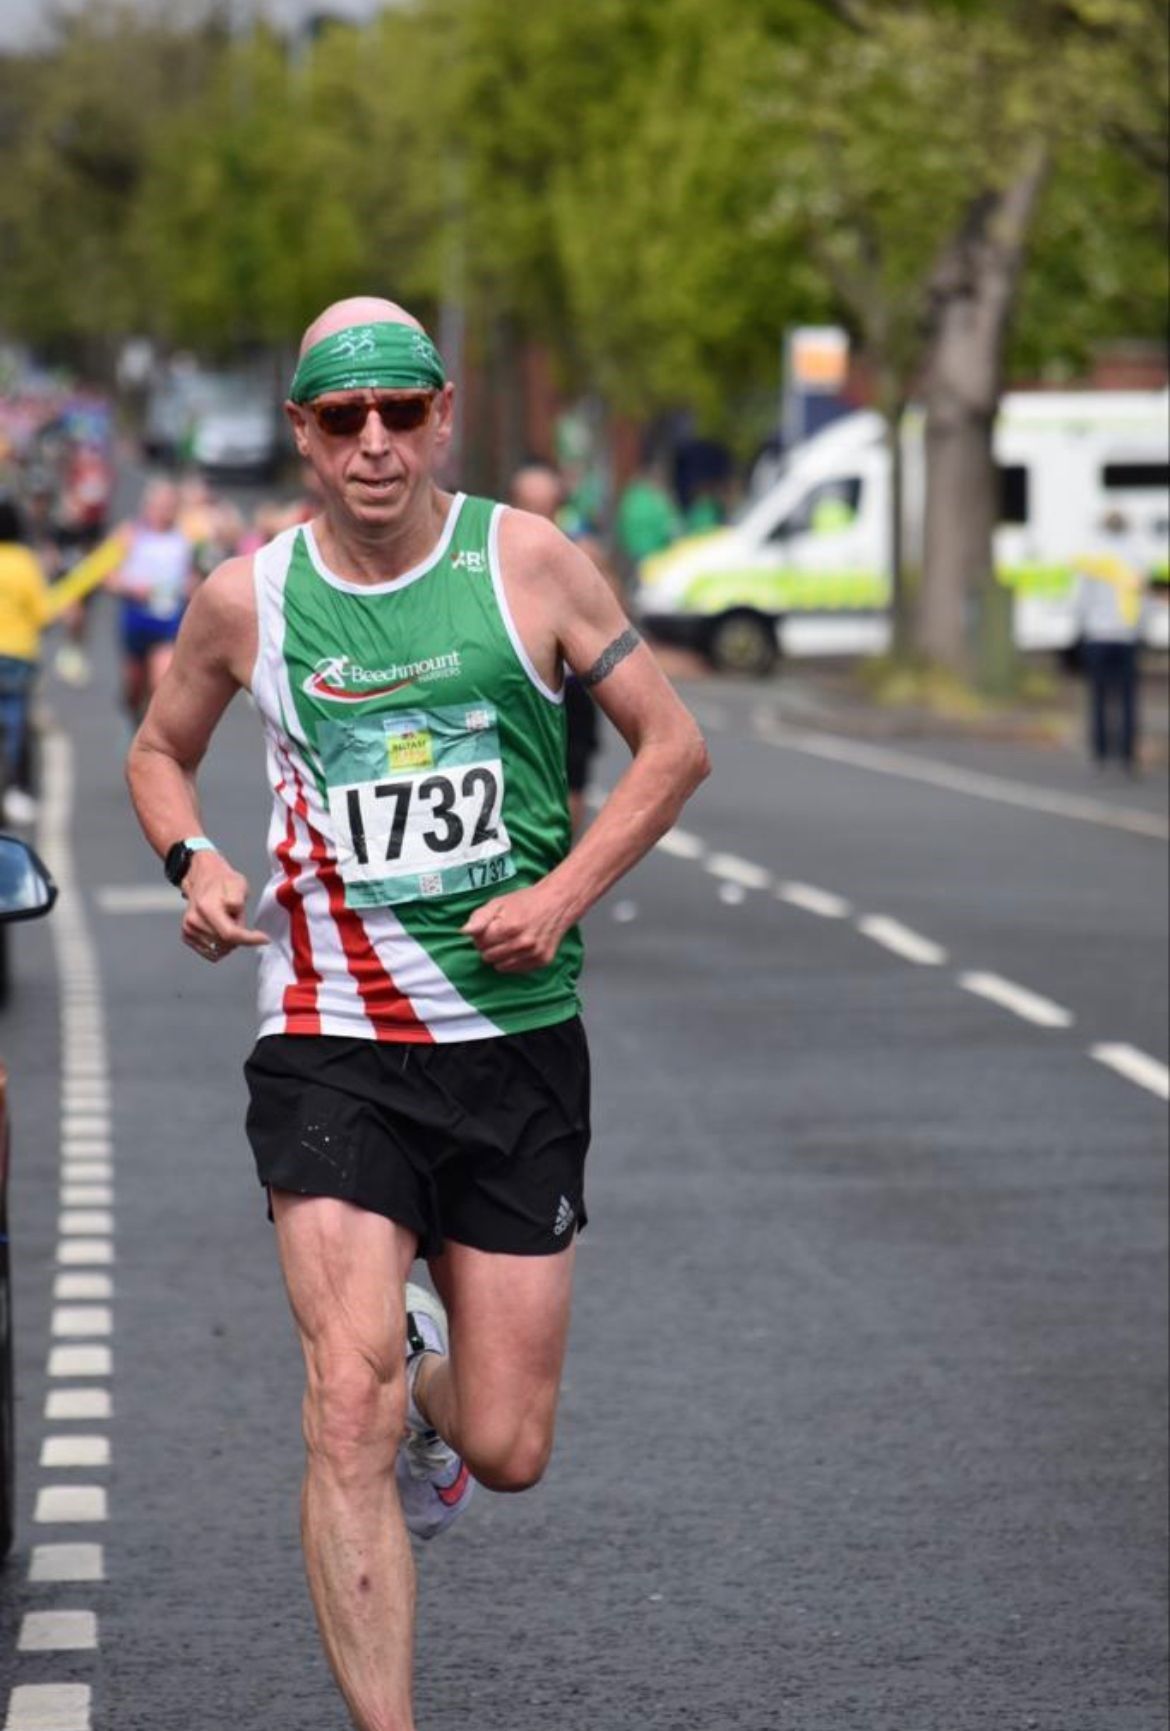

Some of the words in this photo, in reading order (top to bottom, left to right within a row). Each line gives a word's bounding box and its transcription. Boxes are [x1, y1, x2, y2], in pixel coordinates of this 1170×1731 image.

[352, 650, 461, 683] Beechmount
[346, 767, 499, 865] 1732
[467, 857, 509, 888] 1732
